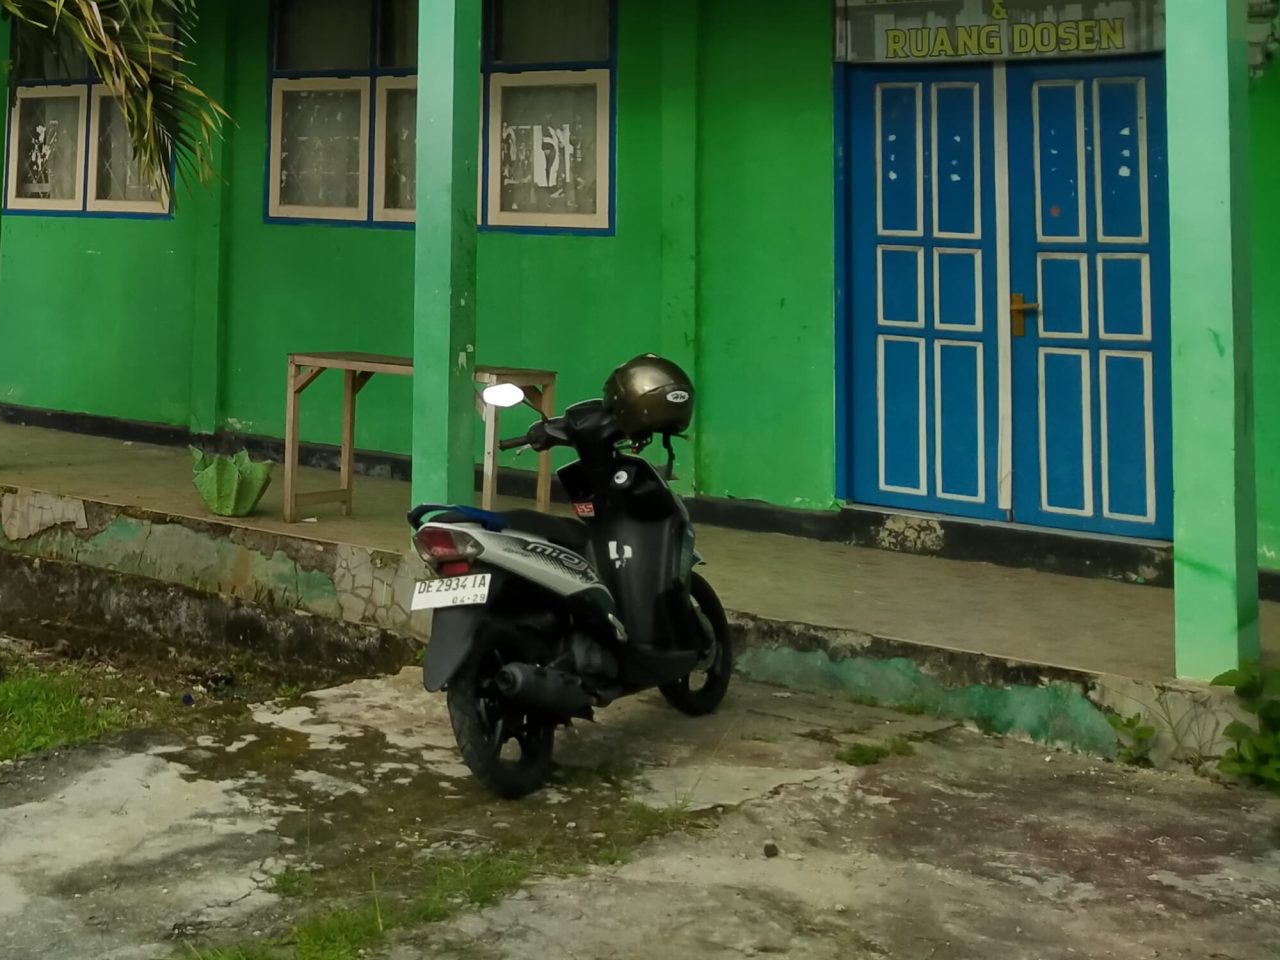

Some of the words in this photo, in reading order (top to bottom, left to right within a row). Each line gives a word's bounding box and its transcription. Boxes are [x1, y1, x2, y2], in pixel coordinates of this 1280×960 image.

[991, 0, 1008, 20] &
[886, 25, 1002, 58] RUANG
[1011, 18, 1125, 52] DOSEN
[418, 580, 434, 594] DE
[435, 577, 468, 592] 2934
